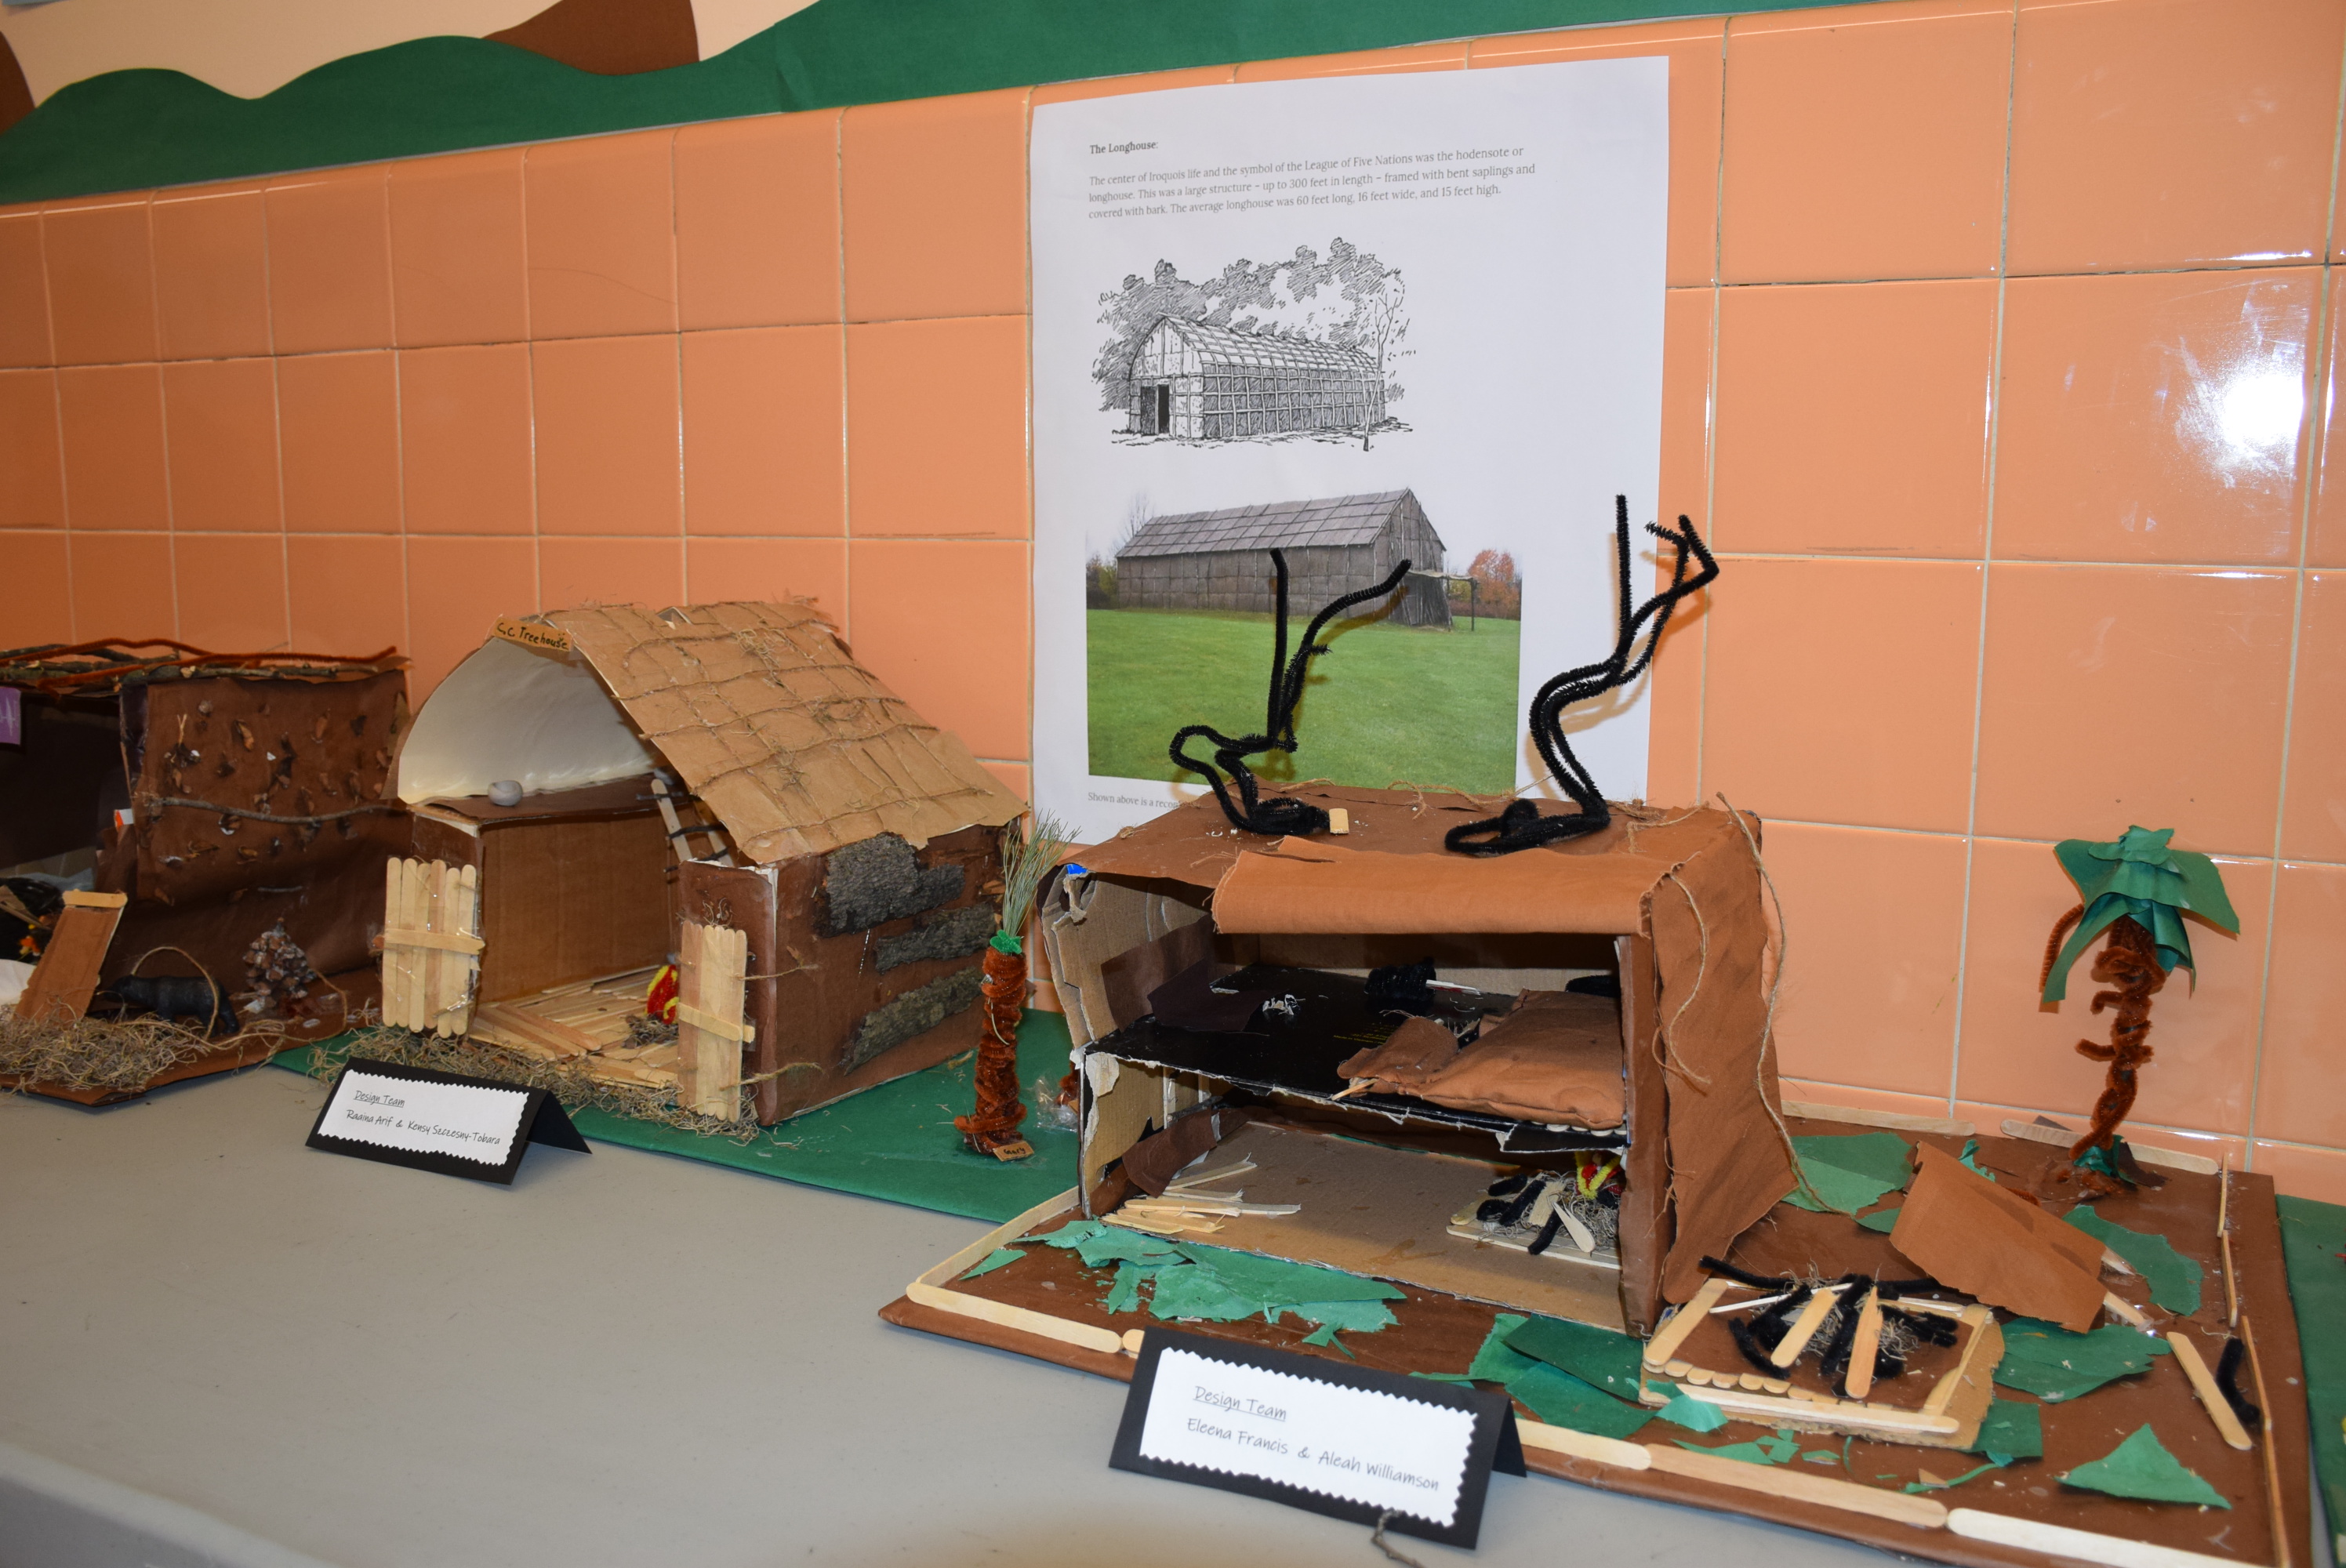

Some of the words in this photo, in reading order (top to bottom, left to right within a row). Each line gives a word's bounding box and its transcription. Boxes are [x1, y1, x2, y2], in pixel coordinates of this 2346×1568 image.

[1090, 144, 1106, 154] The
[1109, 141, 1159, 154] Longhouse:
[1089, 191, 1135, 204] longhouse.
[1138, 189, 1156, 199] This
[1186, 186, 1208, 197] large
[1209, 183, 1251, 194] structure
[1262, 182, 1275, 192] up
[1277, 181, 1287, 190] to
[1289, 178, 1307, 188] 300
[1310, 177, 1327, 187] feet
[1331, 176, 1339, 186] in
[1342, 174, 1372, 187] length
[1385, 171, 1418, 182] framed
[1422, 171, 1444, 180] with
[1447, 169, 1469, 179] bent
[1473, 165, 1513, 178] saplings
[1516, 164, 1535, 173] and
[1090, 176, 1105, 185] The
[1107, 175, 1135, 183] center
[1138, 173, 1147, 182] of
[1149, 171, 1185, 183] Iroquois
[1188, 169, 1200, 179] life
[1203, 167, 1220, 177] and
[1223, 165, 1237, 176] the
[1240, 163, 1273, 177] symbol
[1276, 163, 1285, 172] of
[1287, 162, 1302, 171] the
[1305, 160, 1338, 172] League
[1341, 157, 1351, 167] of
[1353, 157, 1372, 166] Five
[1375, 154, 1413, 165] Nations
[1415, 154, 1434, 162] was
[1436, 151, 1453, 162] the
[1456, 148, 1509, 160] hodensote
[1512, 147, 1523, 156] or
[1089, 209, 1122, 219] covered
[1125, 206, 1144, 216] with
[1146, 204, 1168, 215] bark.
[1171, 203, 1187, 212] The
[1189, 202, 1223, 212] average
[1226, 198, 1273, 211] longhouse
[1297, 196, 1309, 205] 60
[1311, 194, 1329, 204] feet
[1358, 192, 1367, 201] 16
[1371, 191, 1389, 201] feet
[1392, 190, 1418, 201] wide,
[1420, 188, 1438, 198] and
[1442, 187, 1451, 196] 15
[1454, 186, 1473, 196] feet
[1476, 183, 1501, 197] high.
[1088, 792, 1114, 802] Shown
[1117, 796, 1138, 805] above
[1141, 797, 1148, 806] is
[354, 1091, 380, 1105] Design
[383, 1094, 405, 1107] Team
[346, 1110, 373, 1123] Raaina
[376, 1115, 394, 1127] Arif
[408, 1120, 431, 1134] Kensy
[1193, 1385, 1240, 1410] Design
[1247, 1399, 1287, 1421] Team
[1187, 1417, 1232, 1440] Eleena
[1237, 1431, 1288, 1454] Francis
[1298, 1446, 1309, 1459] &
[1318, 1451, 1361, 1472] Aleah
[1366, 1461, 1440, 1491] Williamson
